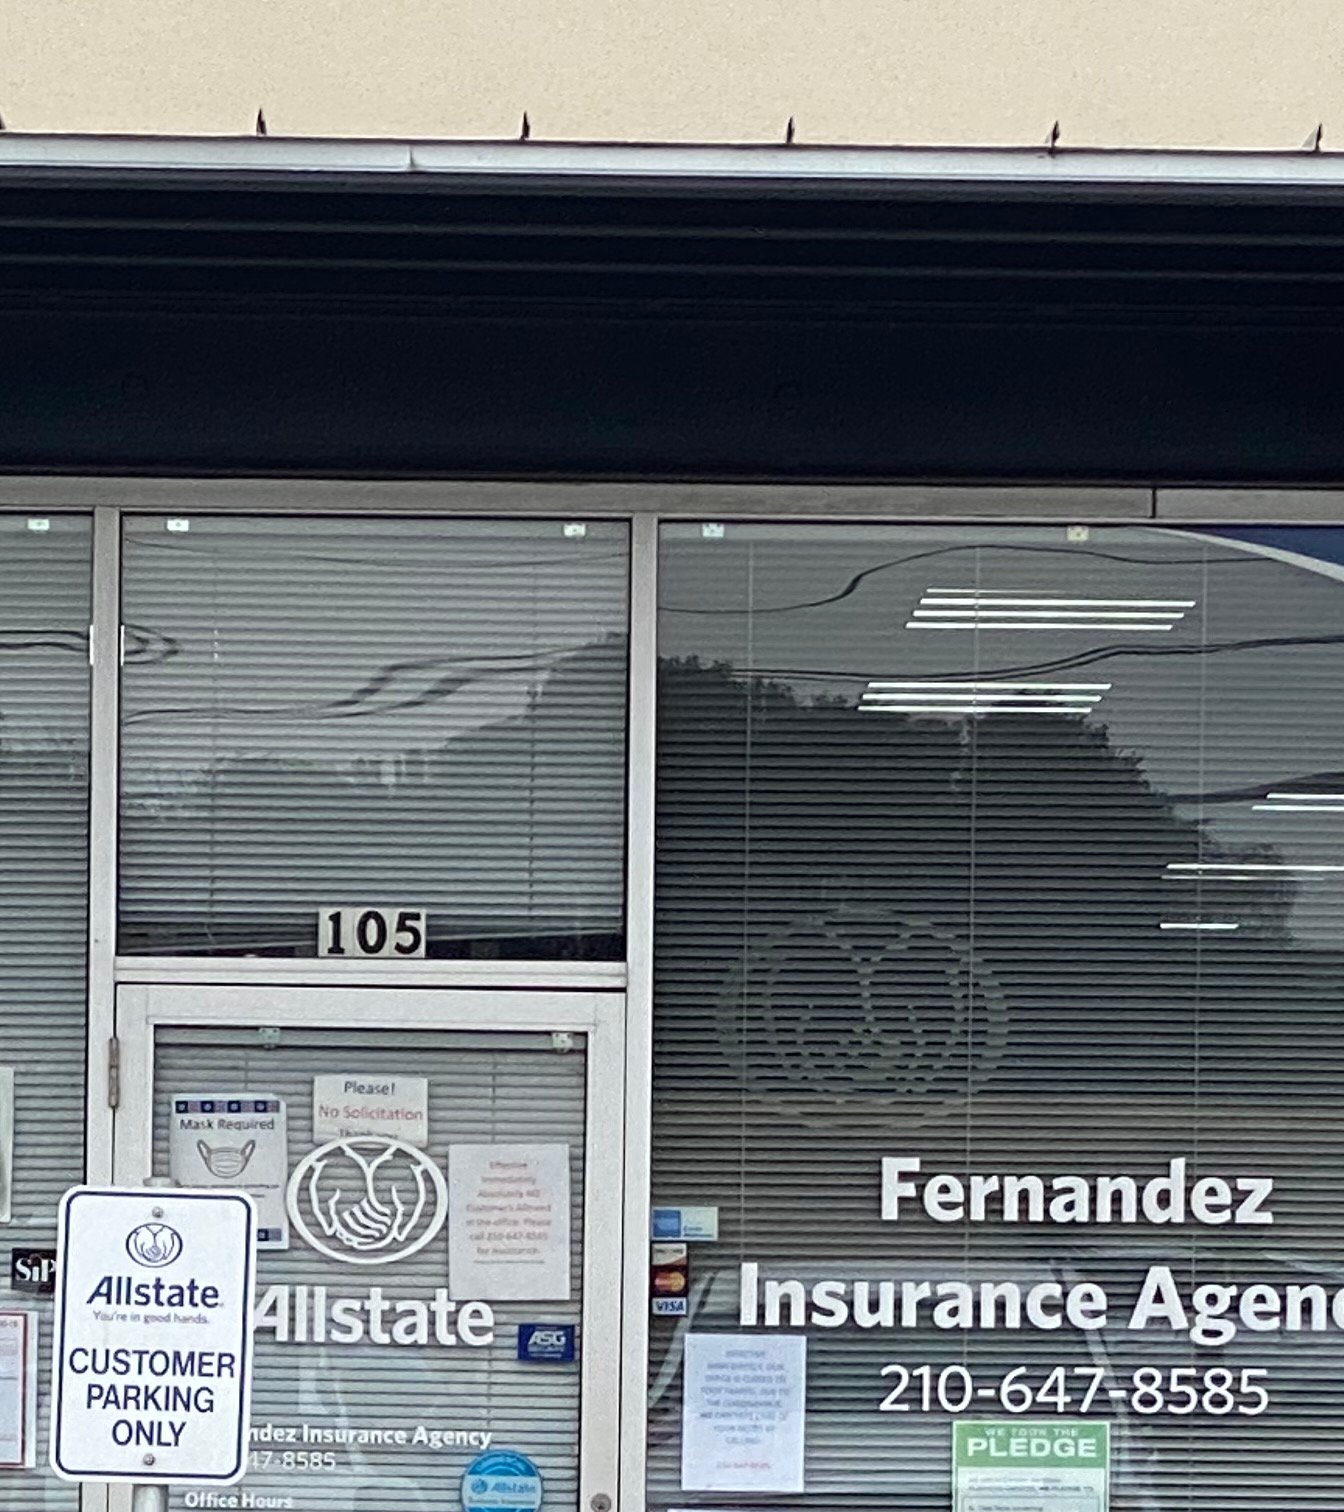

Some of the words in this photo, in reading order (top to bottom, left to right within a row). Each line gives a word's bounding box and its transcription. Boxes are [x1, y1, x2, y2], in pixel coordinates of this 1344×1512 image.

[327, 910, 422, 955] 105
[343, 1080, 396, 1096] Please!
[179, 1118, 215, 1130] Mask
[216, 1118, 275, 1131] Required
[318, 1104, 340, 1119] No
[343, 1105, 425, 1121] Solicitation
[880, 1157, 1275, 1225] Fernandez
[86, 1275, 220, 1308] Allstate
[738, 1262, 1108, 1331] Insurance
[93, 1310, 128, 1323] You're
[129, 1311, 141, 1322] in
[143, 1311, 172, 1325] good
[173, 1310, 211, 1325] hands.
[253, 1285, 495, 1347] Allstate
[655, 1300, 685, 1312] VISA
[68, 1347, 236, 1379] CUSTOMER
[86, 1384, 215, 1413] PARKING
[878, 1363, 1270, 1415] 210-647-8585
[111, 1419, 187, 1448] ONLY
[302, 1425, 407, 1445] Insurance
[412, 1425, 494, 1450] Agency
[984, 1428, 1006, 1437] WE
[1054, 1428, 1080, 1437] THE
[966, 1437, 1098, 1459] PLEDGE
[184, 1491, 238, 1509] Office
[241, 1493, 294, 1509] Hours
